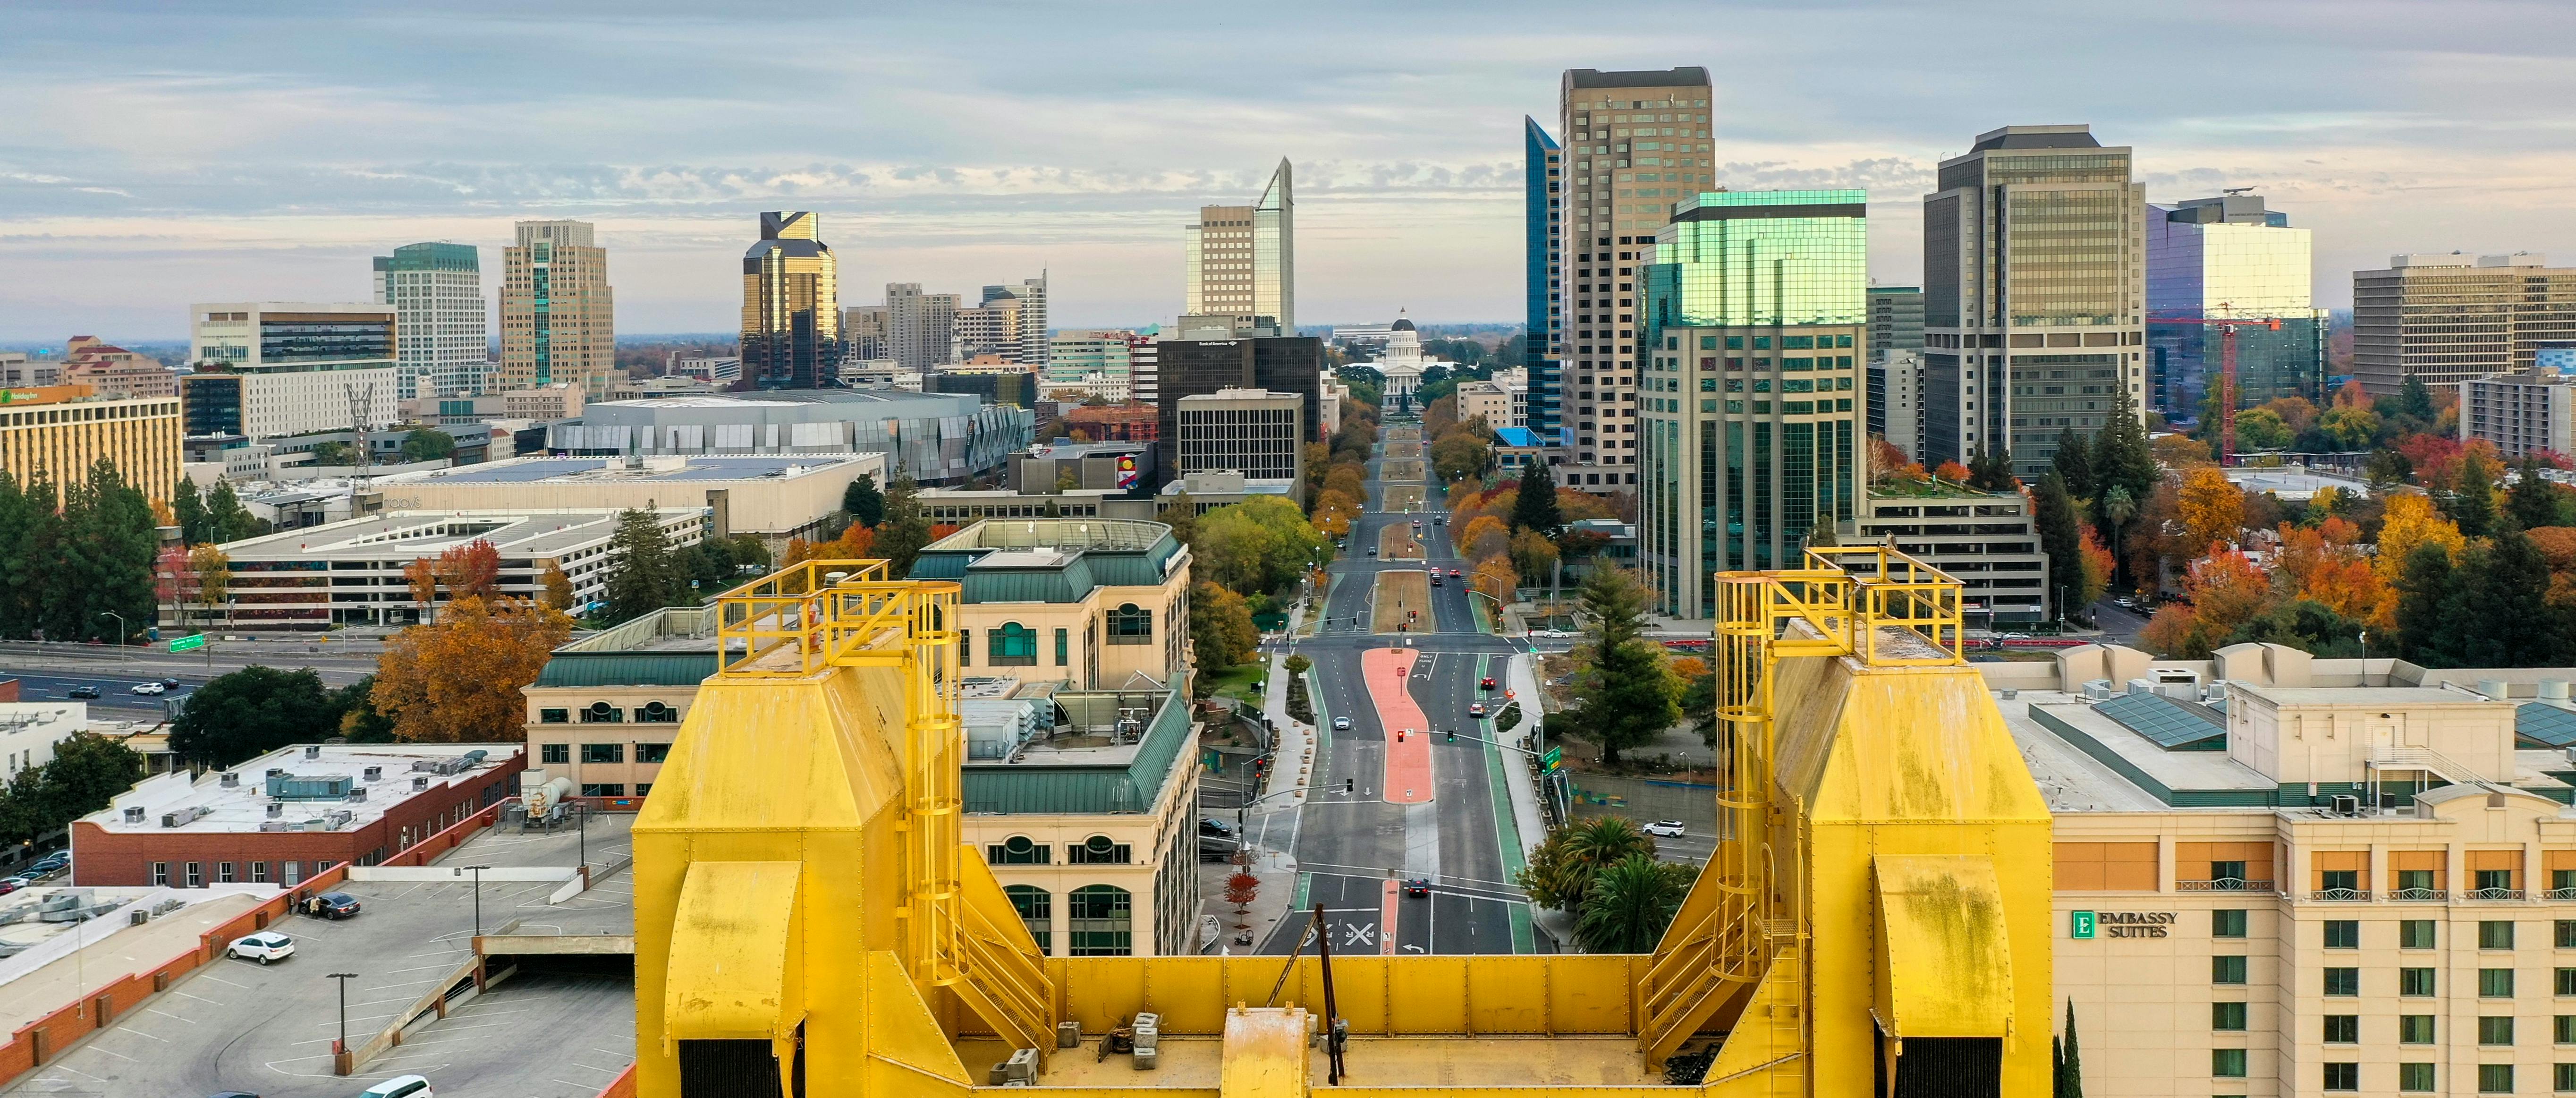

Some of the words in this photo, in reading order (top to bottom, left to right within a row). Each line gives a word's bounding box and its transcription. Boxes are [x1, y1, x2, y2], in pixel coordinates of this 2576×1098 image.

[11, 392, 29, 401] Holiday
[2098, 911, 2178, 924] EMBASSY
[2109, 926, 2167, 938] SUITES
